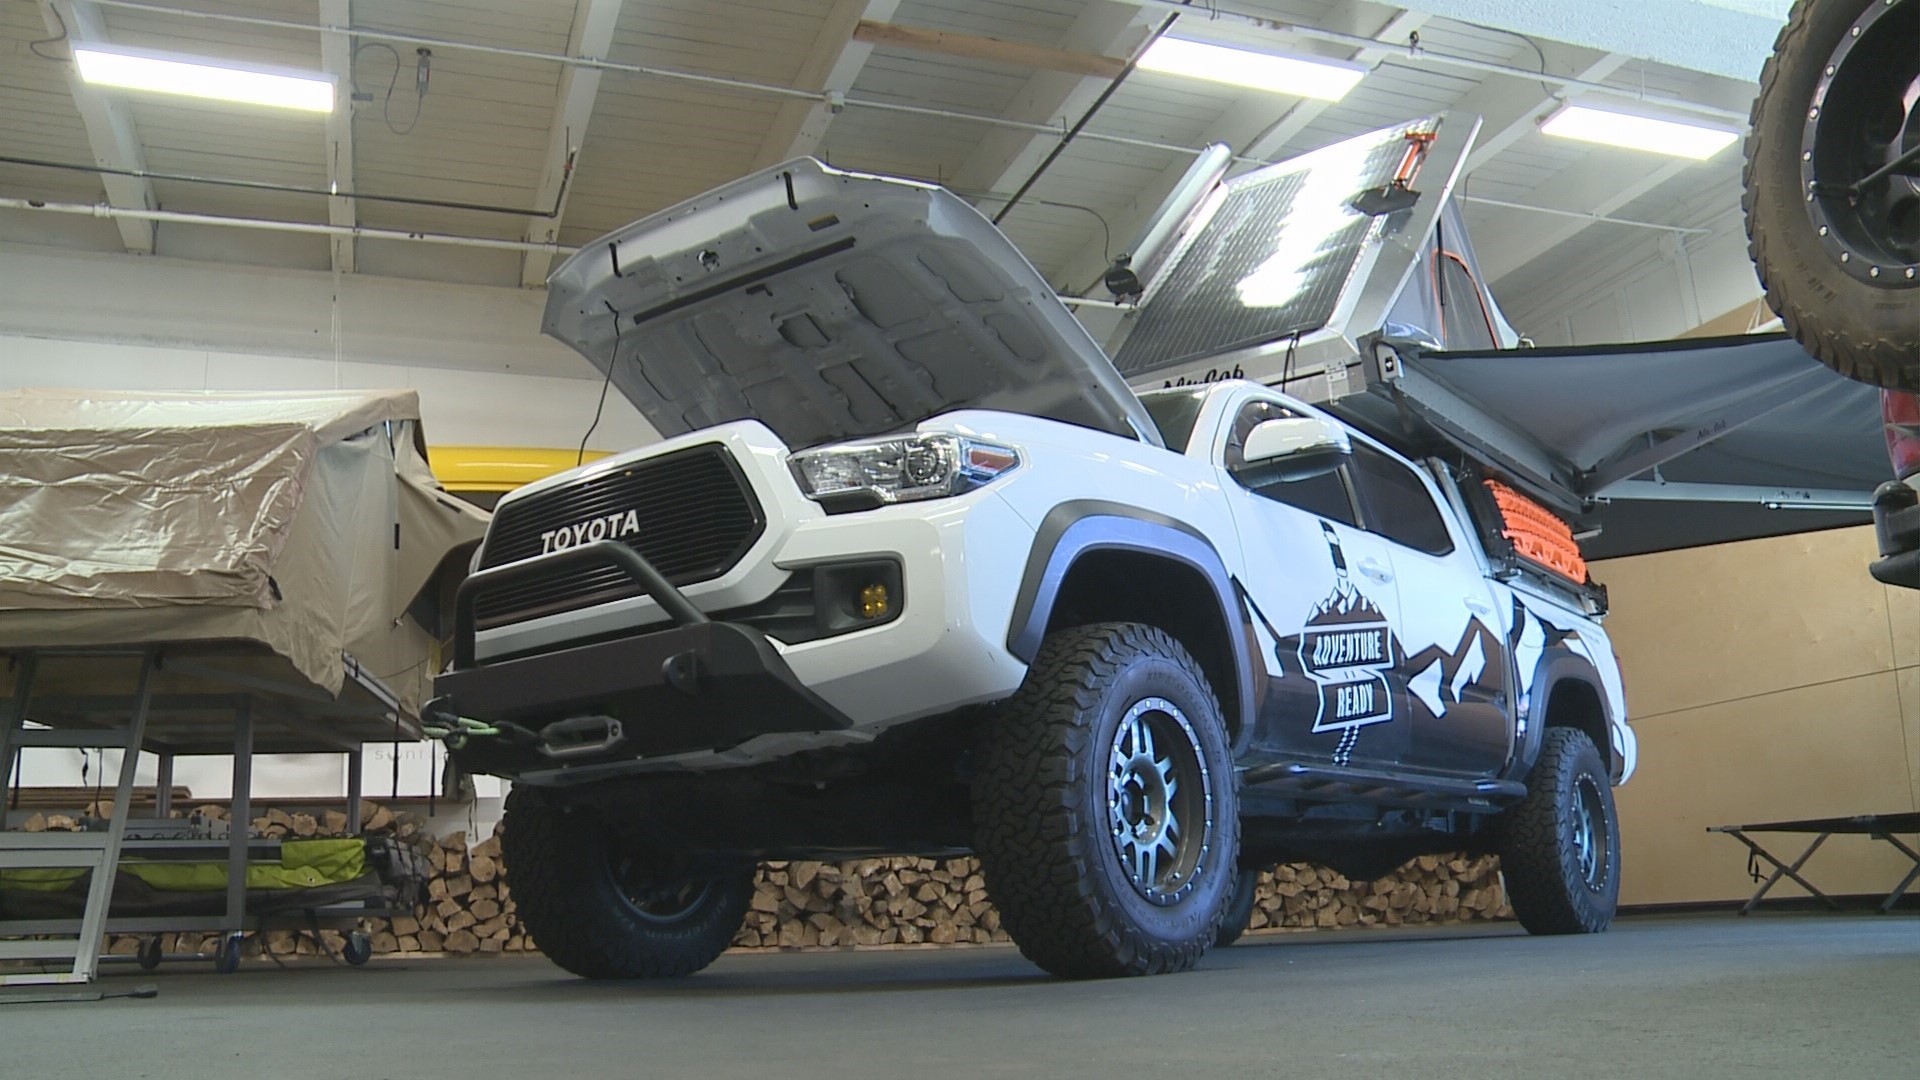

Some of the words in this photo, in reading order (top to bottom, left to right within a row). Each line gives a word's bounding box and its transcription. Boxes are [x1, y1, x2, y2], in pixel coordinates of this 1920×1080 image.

[541, 509, 640, 554] TOYOTA
[1312, 630, 1382, 667] ADVENTURE
[1336, 683, 1374, 718] READY
